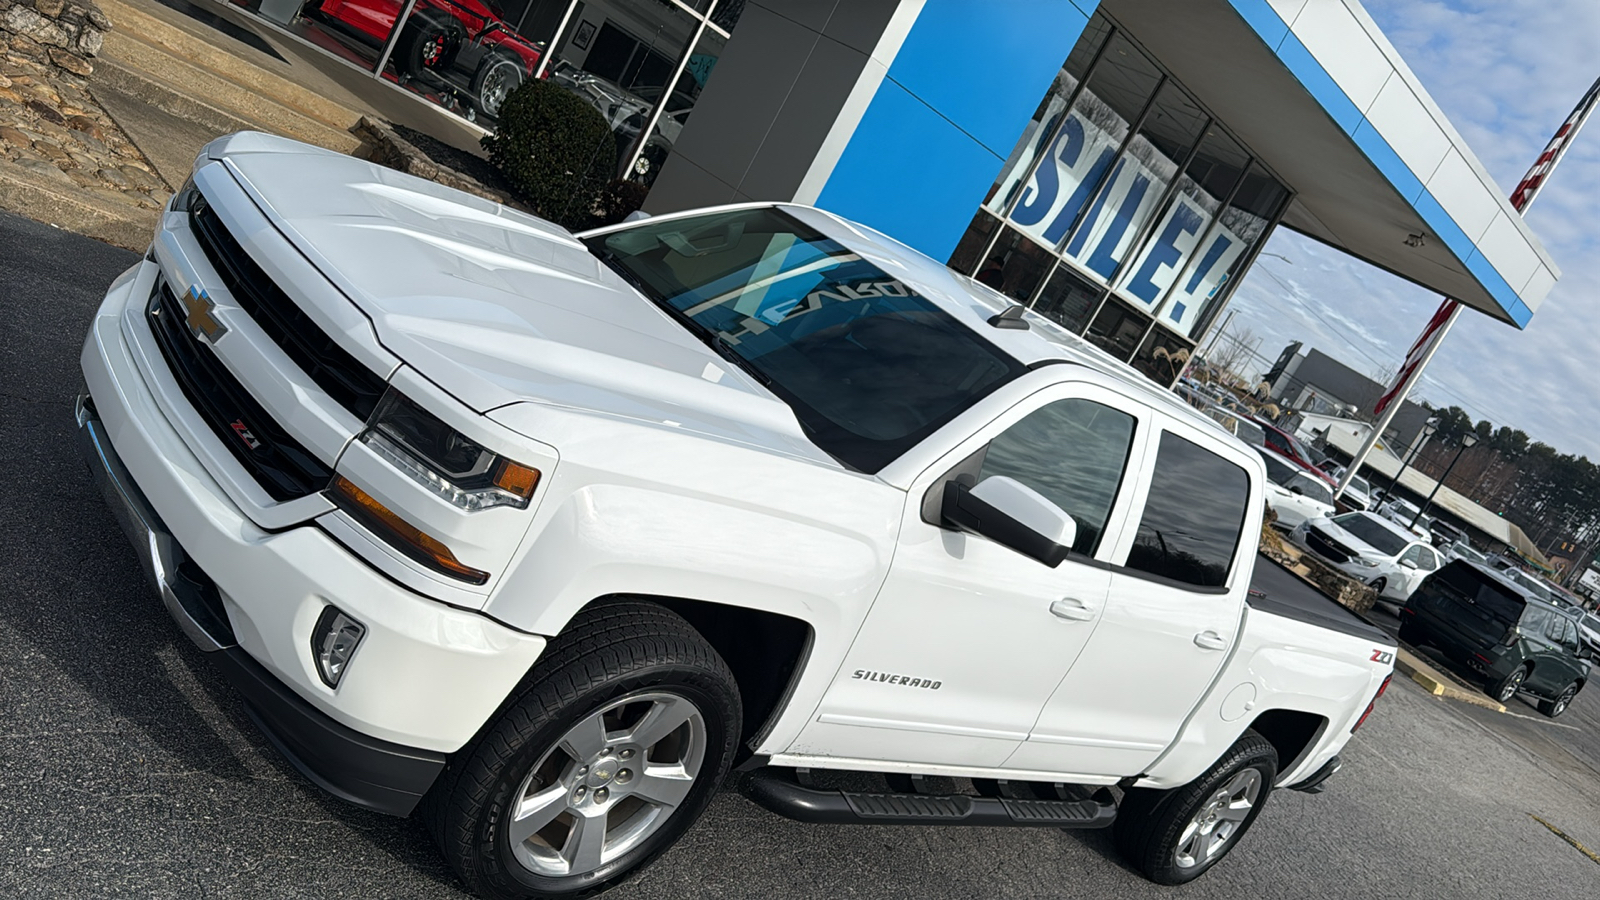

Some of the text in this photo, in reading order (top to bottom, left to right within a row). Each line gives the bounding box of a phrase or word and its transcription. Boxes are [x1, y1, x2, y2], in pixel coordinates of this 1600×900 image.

[1004, 112, 1232, 324] SALE!
[230, 419, 261, 450] Z71
[1370, 649, 1394, 665] Z71
[851, 669, 942, 690] SILVERADO
